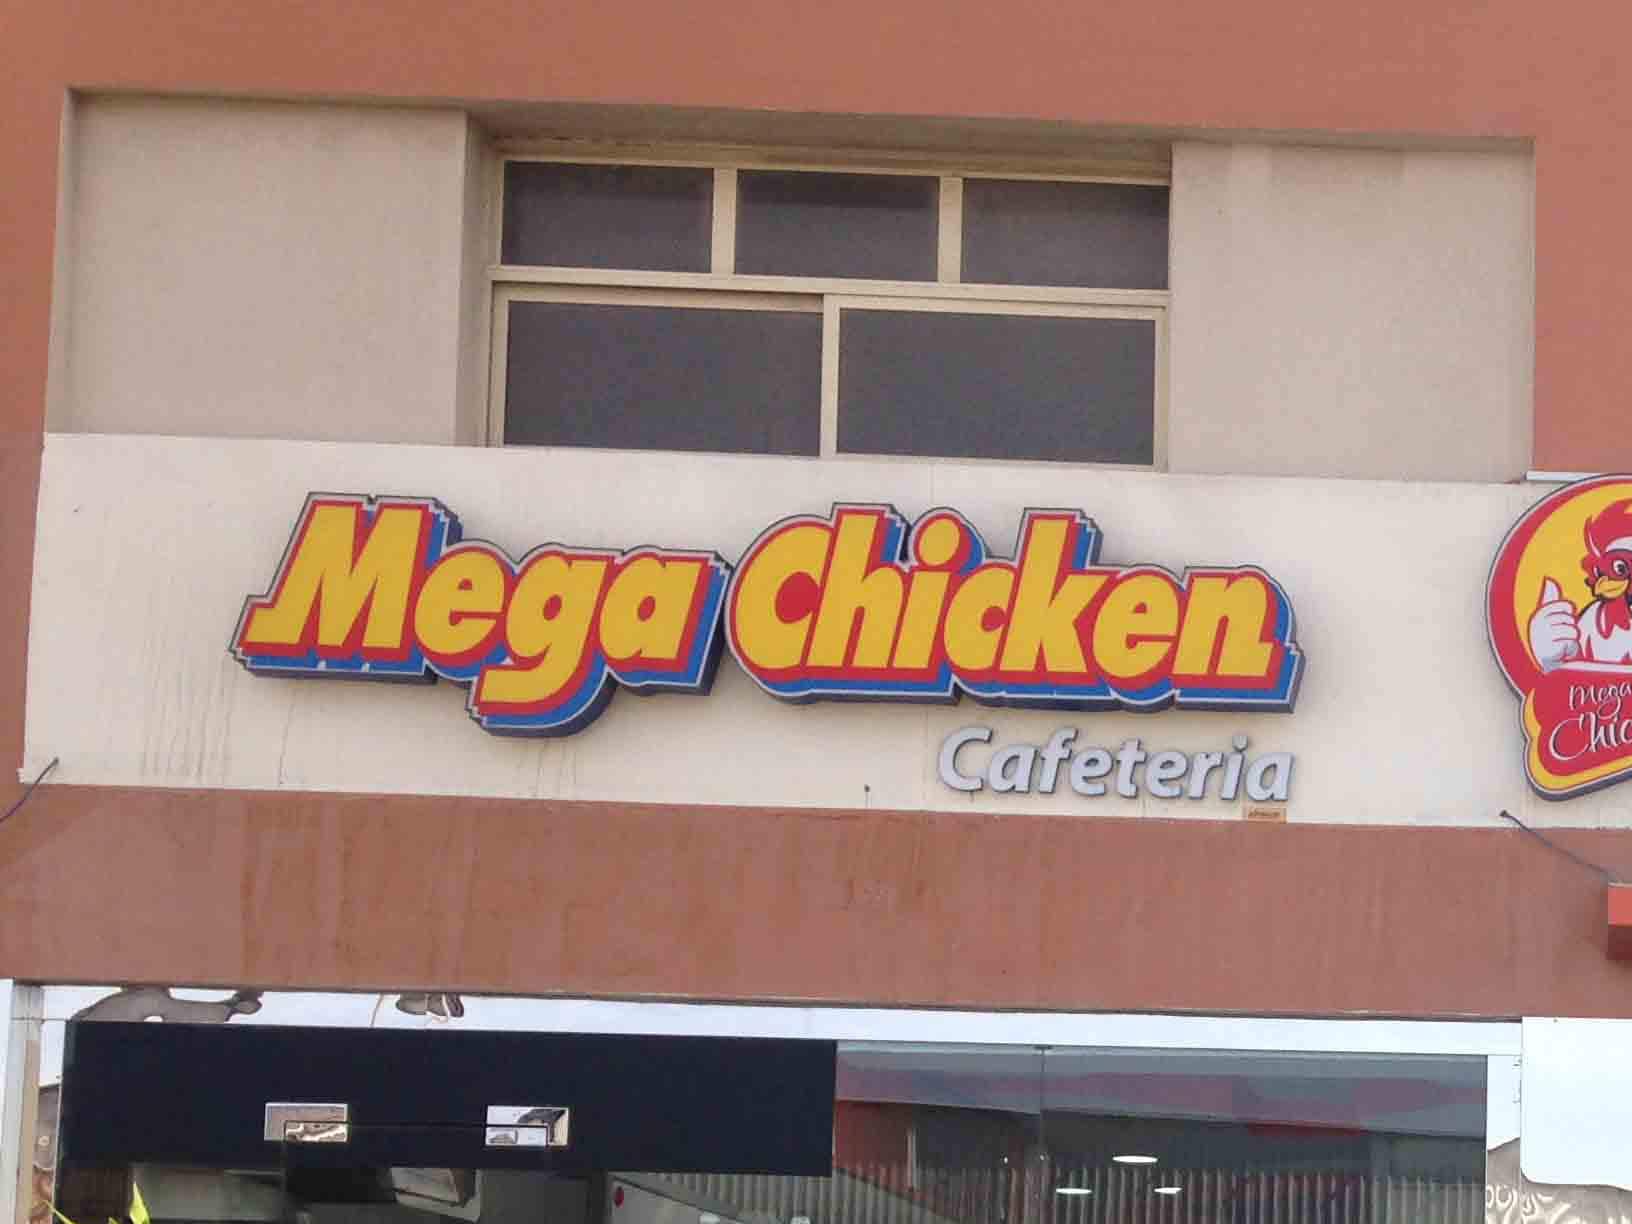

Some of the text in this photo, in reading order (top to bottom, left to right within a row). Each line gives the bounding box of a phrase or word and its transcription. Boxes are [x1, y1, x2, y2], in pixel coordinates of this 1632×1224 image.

[235, 494, 1304, 734] Mega Chicken
[1568, 680, 1632, 721] Mega
[937, 725, 1294, 801] Cafeteria
